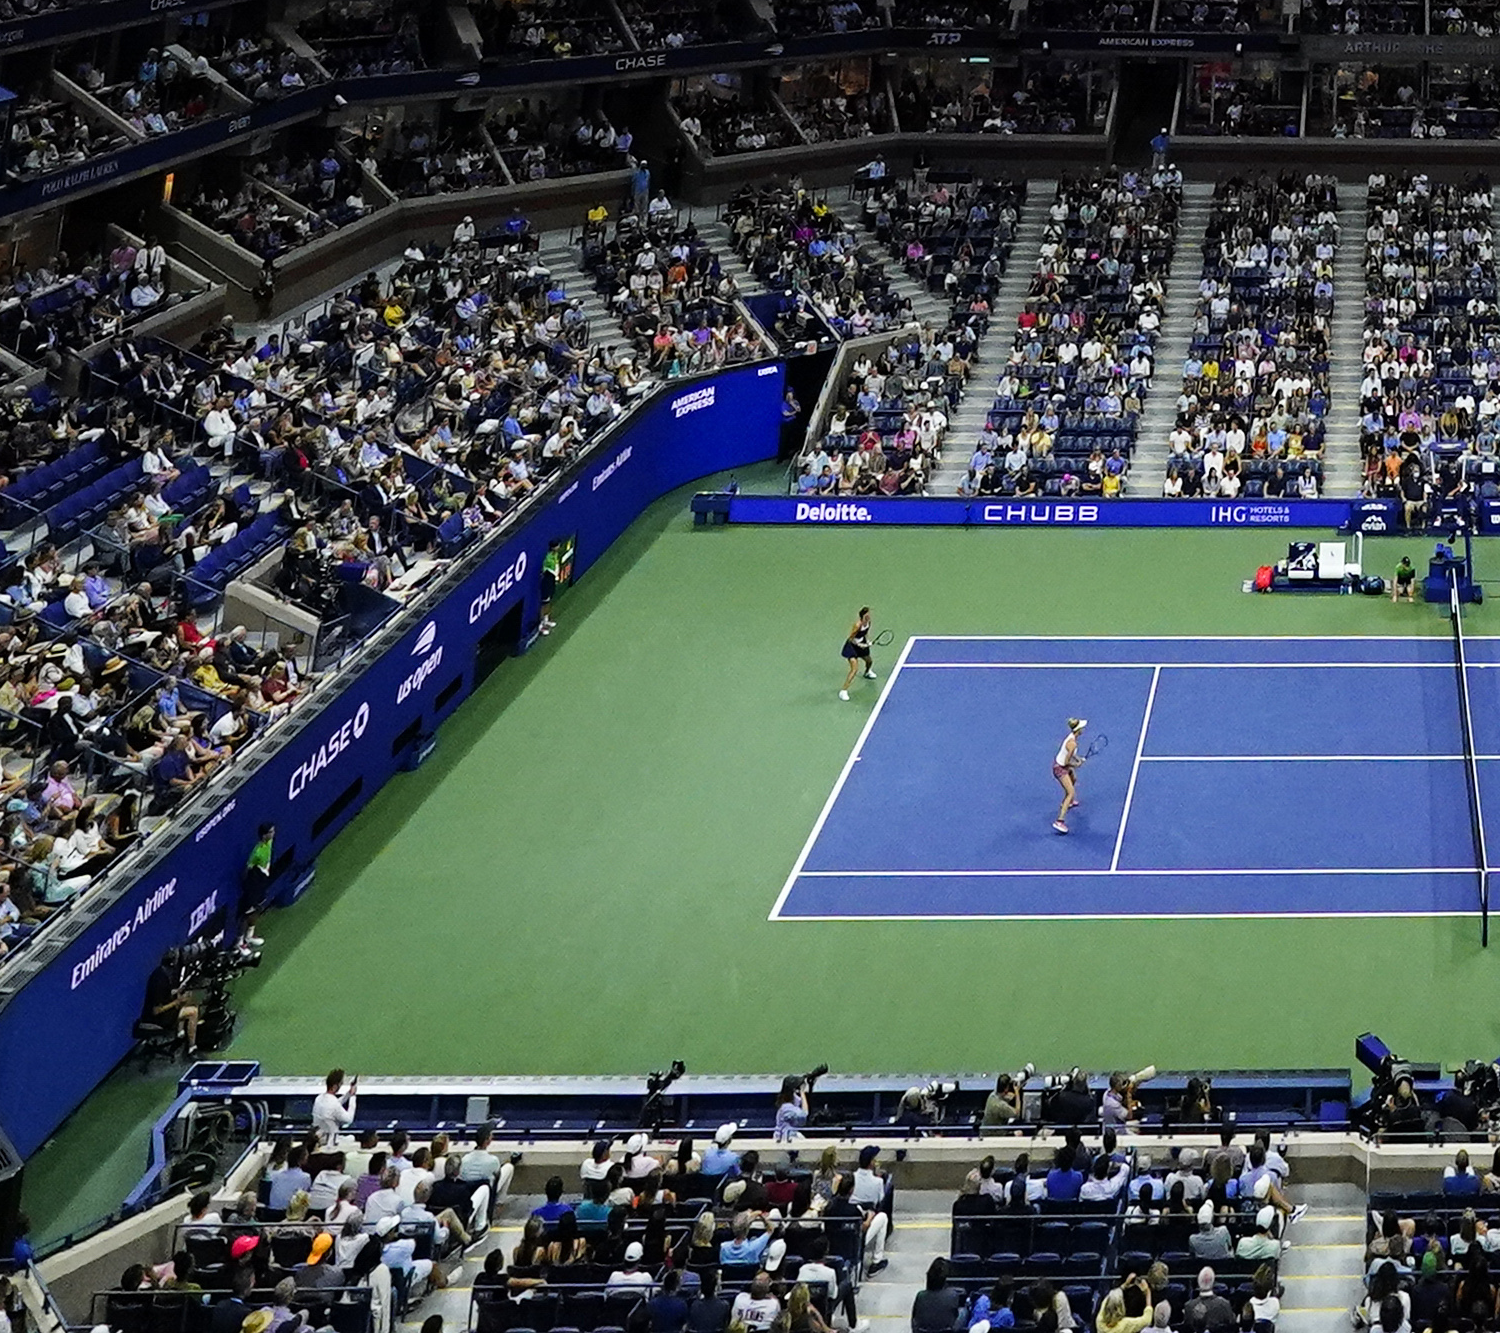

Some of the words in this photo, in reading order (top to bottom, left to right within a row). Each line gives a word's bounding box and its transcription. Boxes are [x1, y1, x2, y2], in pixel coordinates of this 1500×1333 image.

[925, 32, 963, 45] ATP
[1097, 38, 1149, 47] AMERICAN
[1151, 38, 1195, 48] EXPRESS
[1344, 42, 1399, 54] ARTHUR
[615, 53, 667, 72] CHASE
[671, 385, 716, 411] AMERICAN
[674, 395, 716, 419] EXPRESS
[795, 502, 873, 522] Deloitte.
[984, 504, 1100, 523] CHUBB
[1211, 506, 1247, 523] IHG
[1249, 506, 1284, 515] HOTELS
[1249, 515, 1290, 524] RESORTS
[1361, 520, 1387, 531] evian
[468, 563, 516, 625] CHASE
[395, 674, 414, 705] us
[412, 644, 444, 691] open
[287, 723, 352, 801] CHASE
[187, 888, 219, 937] IBM
[69, 920, 131, 991] Emirates
[131, 877, 178, 934] Airline
